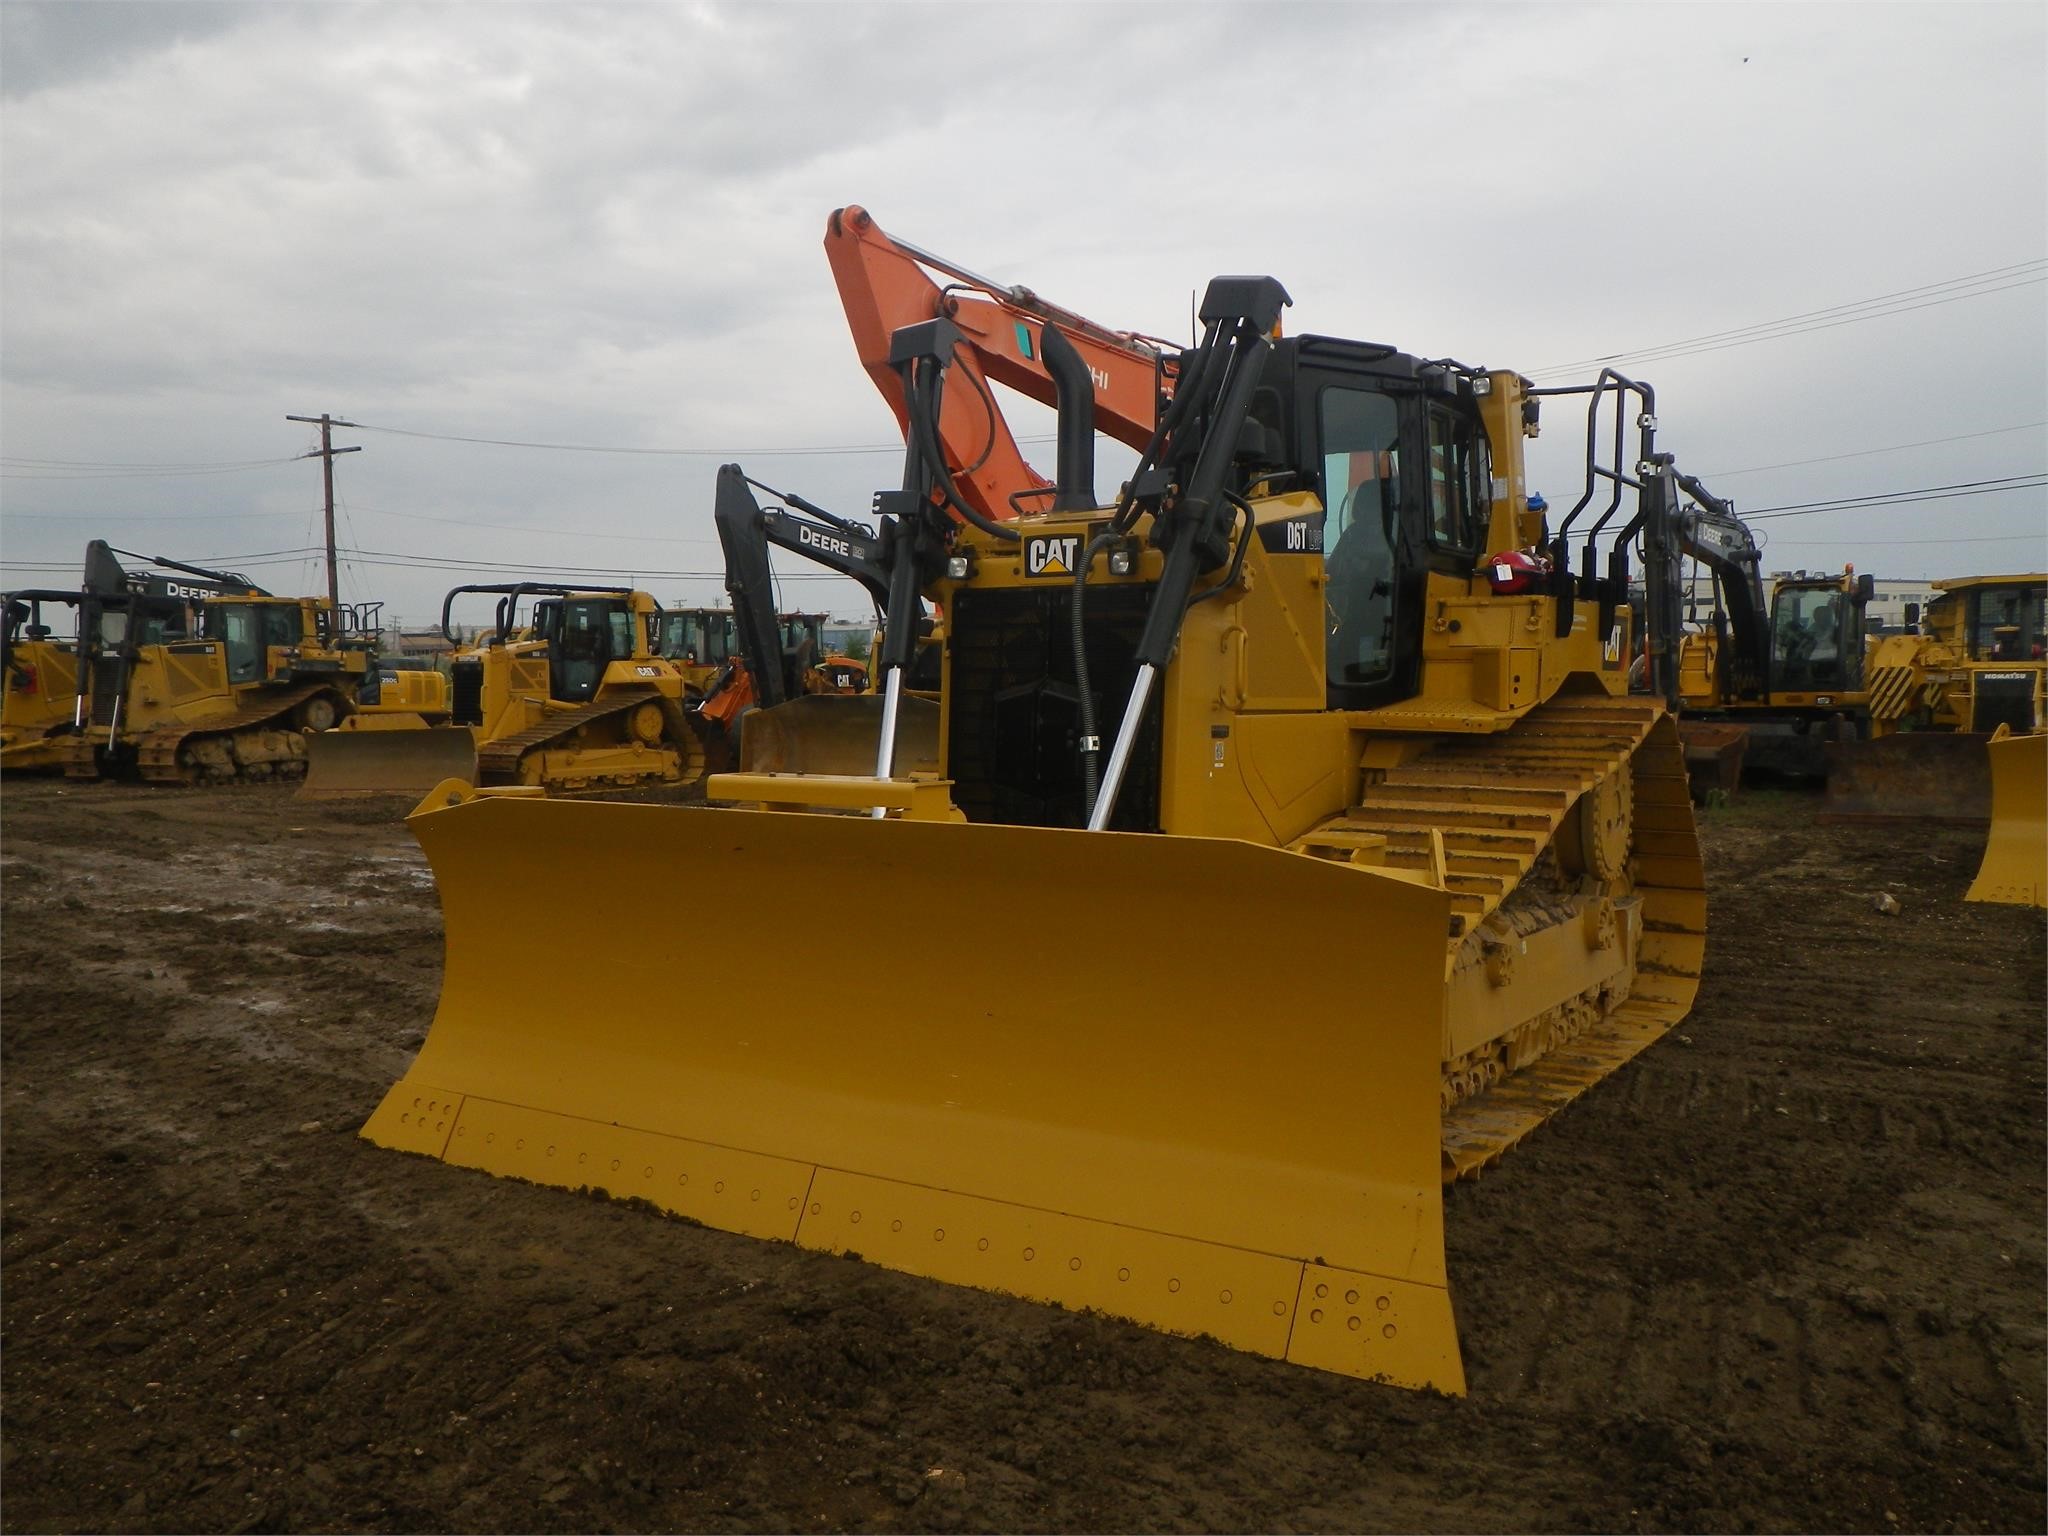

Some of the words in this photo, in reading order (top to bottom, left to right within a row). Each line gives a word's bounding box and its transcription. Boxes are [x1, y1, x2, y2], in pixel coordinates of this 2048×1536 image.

[800, 525, 849, 557] DEERE
[1287, 521, 1307, 550] D6T
[1029, 538, 1078, 573] CAT
[637, 667, 655, 676] CAT
[837, 674, 849, 687] CAT
